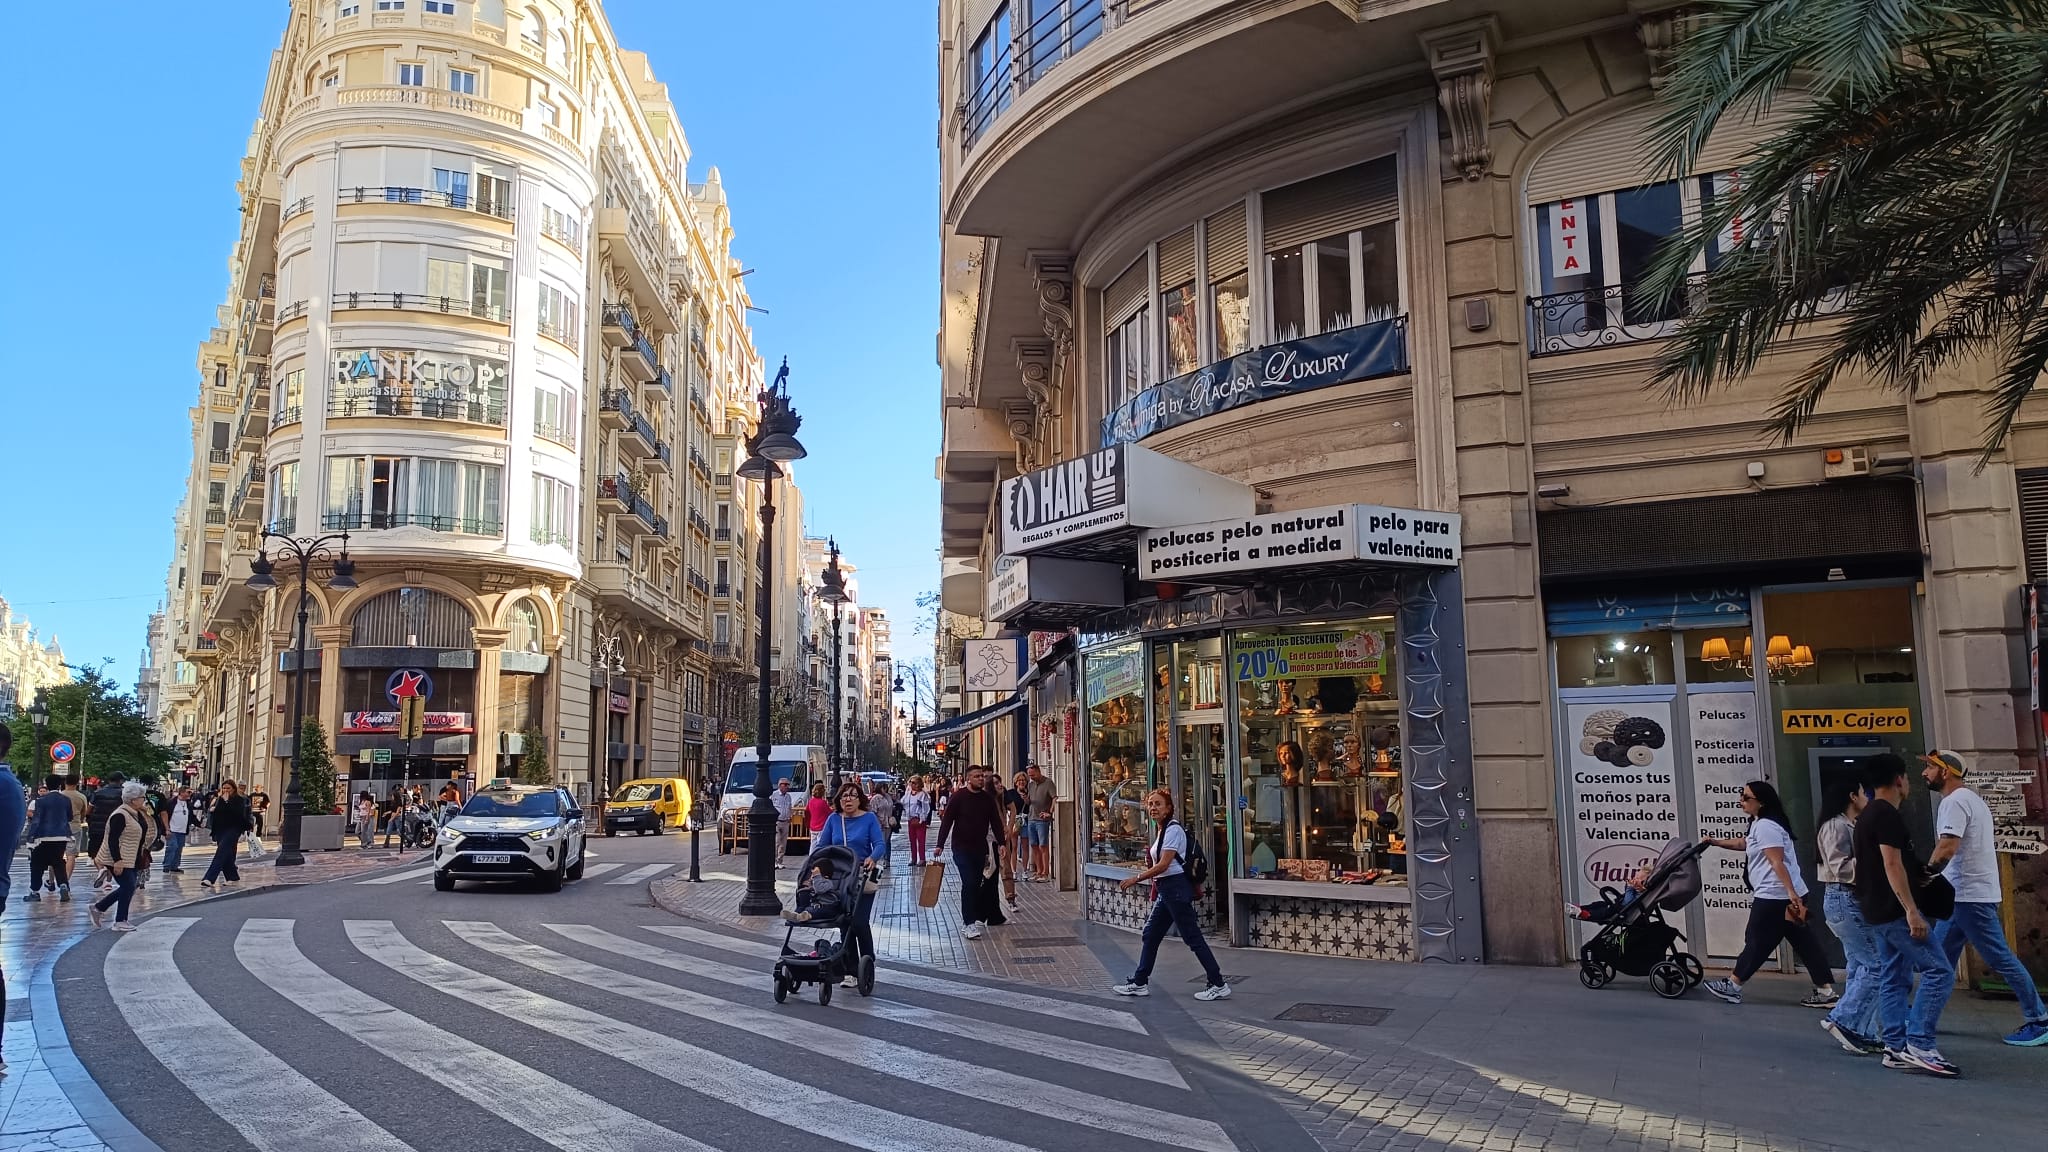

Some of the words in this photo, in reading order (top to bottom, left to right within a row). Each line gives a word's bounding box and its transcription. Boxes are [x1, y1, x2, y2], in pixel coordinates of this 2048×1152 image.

[1169, 398, 1184, 415] by
[1261, 350, 1349, 386] LUXURY
[1040, 457, 1090, 523] HAIR
[1092, 448, 1116, 480] UP
[1022, 529, 1054, 545] REGALOS
[1055, 527, 1061, 536] Y
[1063, 511, 1125, 534] COMPLEMENTOS
[1148, 530, 1215, 552] pelucas
[1221, 521, 1263, 548] pelo
[1271, 510, 1344, 535] natural
[1369, 513, 1407, 533] pelo
[1413, 518, 1449, 537] para
[1151, 550, 1240, 574] posticeria
[1247, 548, 1260, 560] a
[1267, 535, 1342, 558] medida
[1367, 538, 1453, 561] valenciana
[1235, 639, 1276, 650] Aprovecha
[1276, 637, 1289, 647] los
[1290, 633, 1343, 645] DESCUENTOS!
[1289, 651, 1298, 661] En
[1299, 651, 1306, 660] el
[1307, 649, 1333, 659] cosido
[1334, 648, 1344, 658] de
[1237, 647, 1290, 680] 20%
[1289, 662, 1315, 673] moños
[1316, 662, 1333, 672] para
[1334, 660, 1379, 671] Valenciana
[1699, 710, 1746, 720] Pelucas
[1786, 714, 1833, 728] ATM
[1843, 712, 1907, 730] Cajero
[1695, 739, 1755, 749] Posticeria
[1697, 755, 1705, 764] a
[1707, 753, 1754, 764] medida
[1575, 772, 1643, 784] Cosemos
[1646, 772, 1671, 784] tus
[1580, 791, 1633, 803] moños
[1636, 793, 1671, 806] para
[1578, 809, 1591, 821] el
[1594, 809, 1654, 824] peinado
[1657, 809, 1676, 821] de
[1585, 827, 1670, 840] Valenciana
[1704, 884, 1751, 894] Peinado
